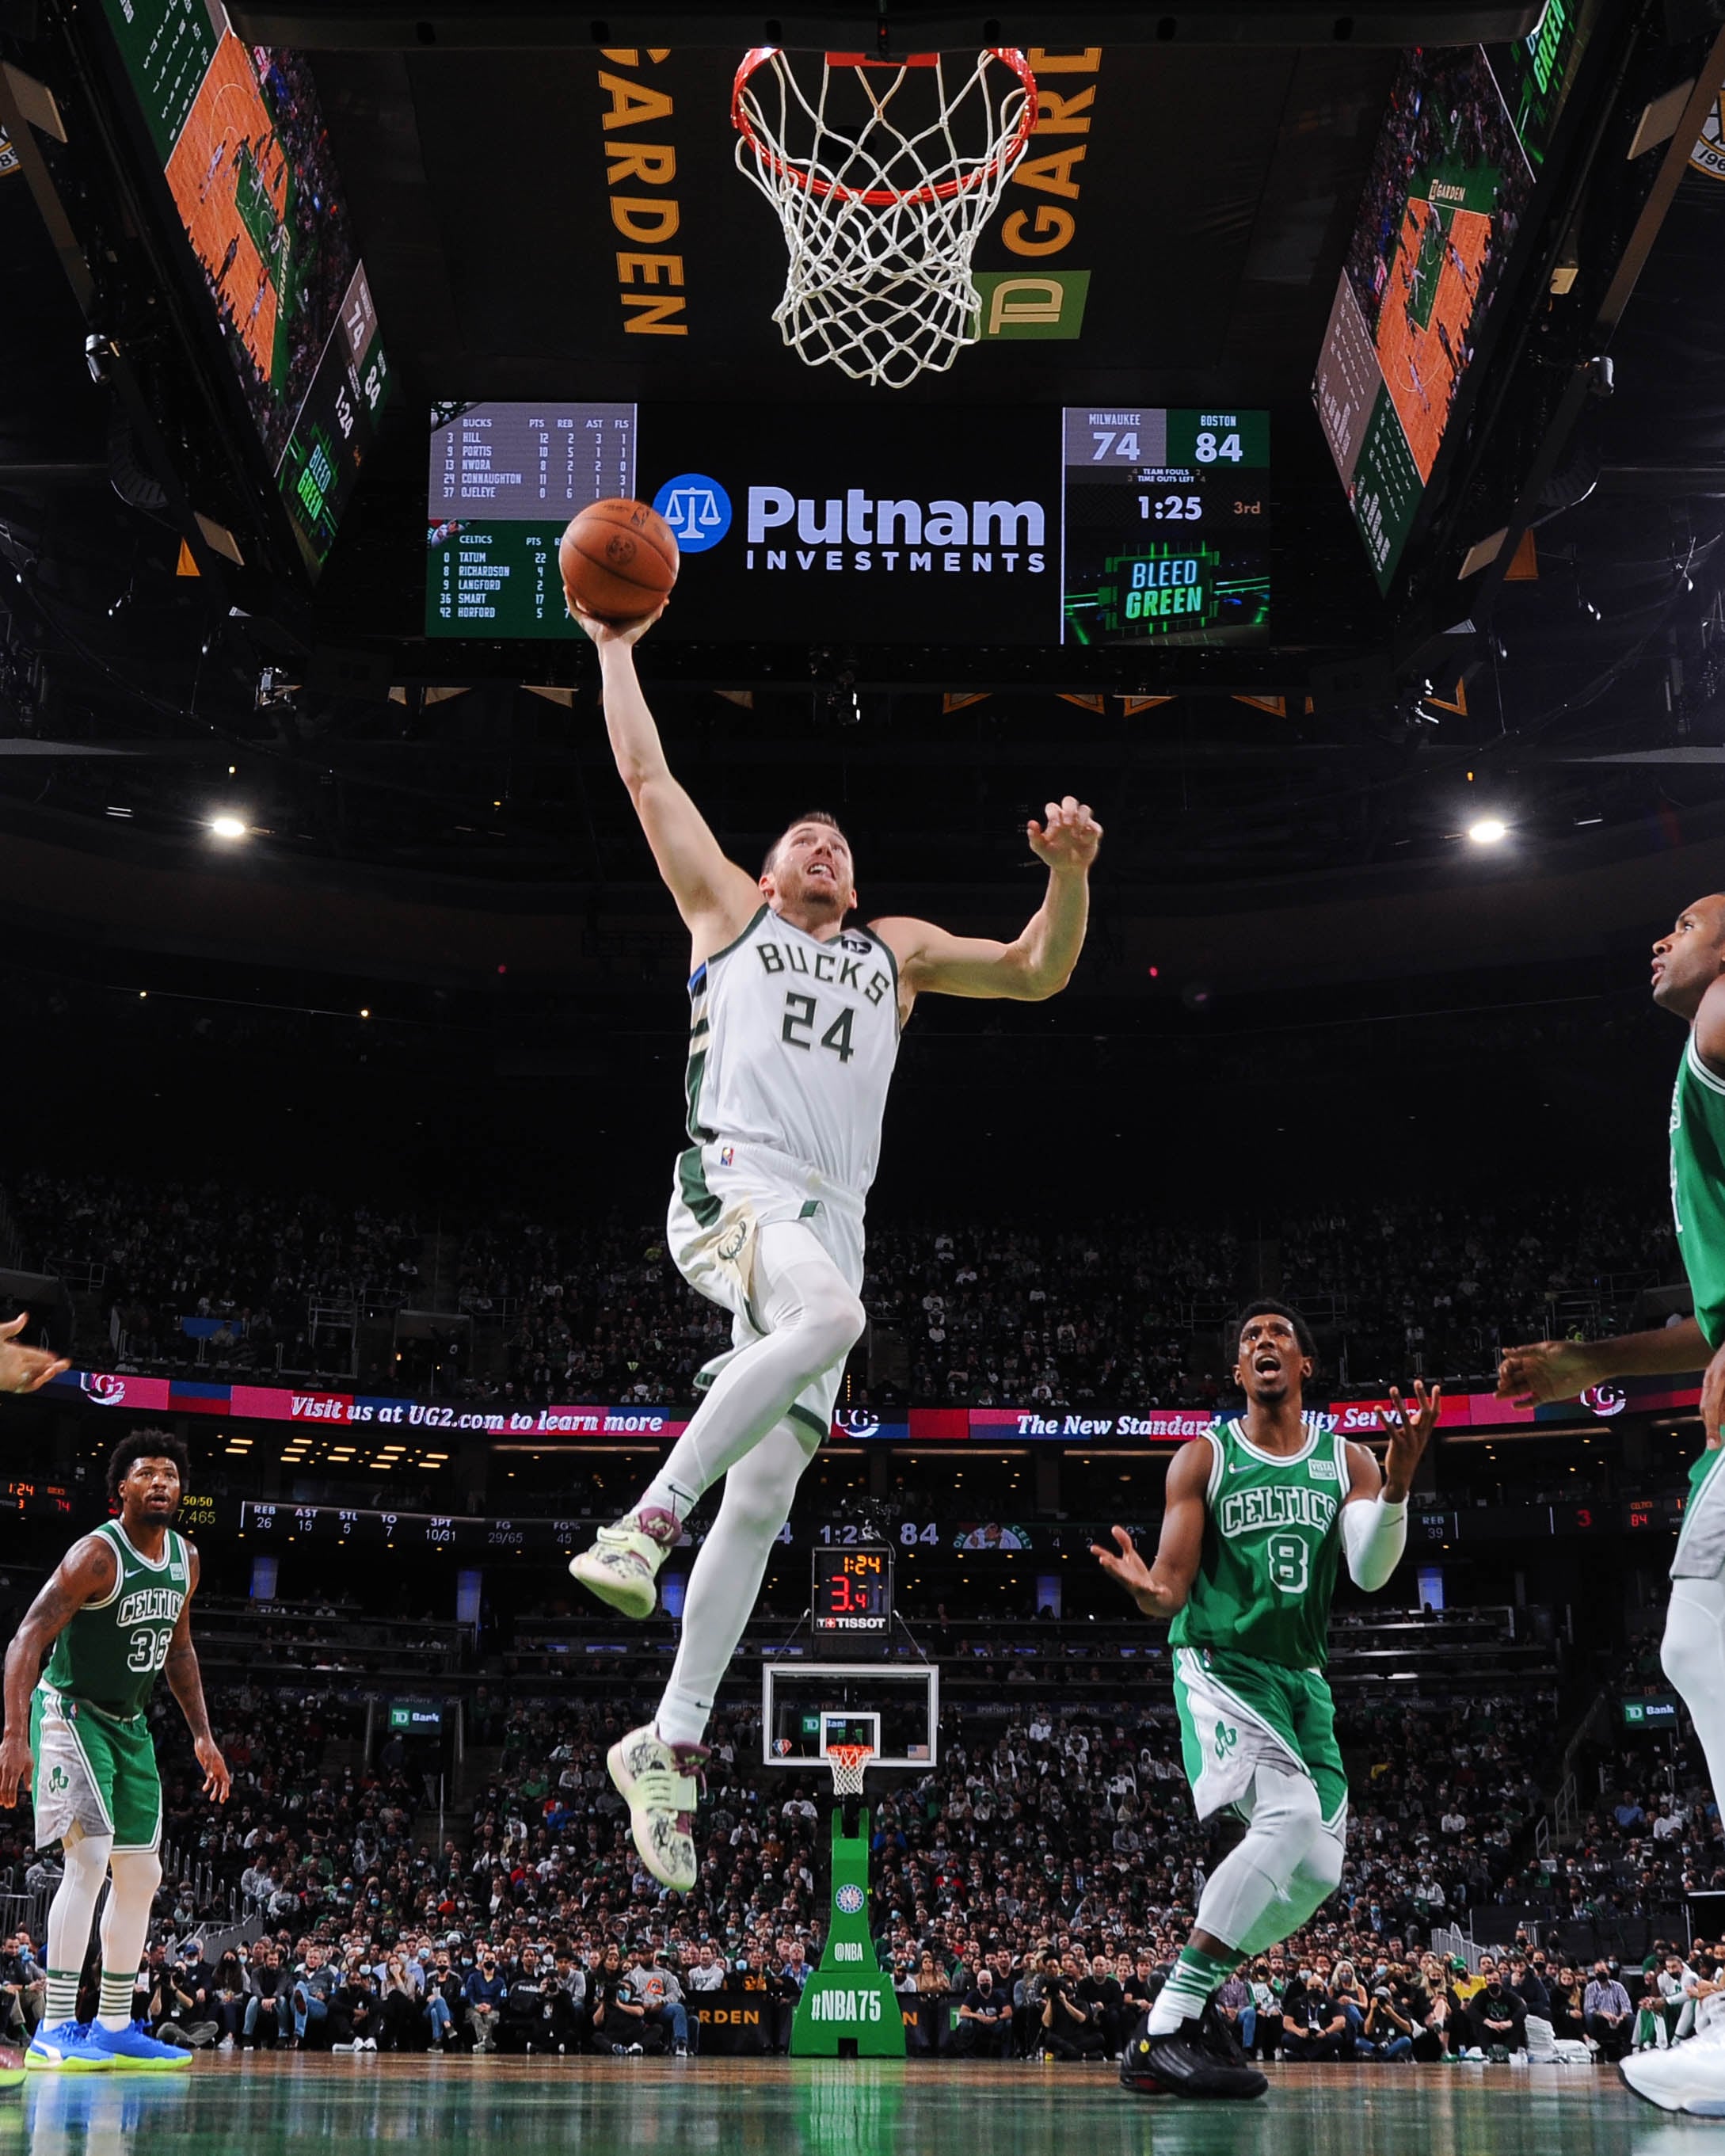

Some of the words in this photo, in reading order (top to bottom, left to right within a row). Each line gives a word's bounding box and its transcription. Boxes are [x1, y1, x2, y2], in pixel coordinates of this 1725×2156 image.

[988, 277, 1064, 334] TD
[558, 420, 573, 429] REB
[586, 420, 603, 429] AST
[1089, 413, 1140, 425] MILWAUKEE
[1201, 415, 1236, 426] BOSTON
[447, 433, 453, 443] 3
[463, 432, 481, 443] HILL
[540, 434, 548, 444] 12
[568, 434, 574, 444] 2
[596, 434, 601, 444] 3
[622, 434, 626, 444] 1
[447, 447, 453, 456] 9
[463, 447, 492, 456] PORTIS
[539, 448, 548, 457] 10
[567, 448, 573, 457] 5
[596, 448, 600, 457] 1
[622, 448, 626, 458] 1
[1092, 432, 1140, 461] 74
[1195, 432, 1243, 463] 84
[446, 460, 454, 470] 13
[462, 460, 490, 470] NWORA
[540, 461, 546, 470] 8
[567, 461, 573, 470] 2
[596, 461, 601, 470] 2
[620, 462, 626, 470] 0
[462, 474, 521, 484] CONNAUGHTON
[539, 474, 546, 484] 11
[568, 475, 572, 484] 1
[596, 475, 600, 485] 1
[619, 475, 626, 485] 3
[444, 488, 454, 497] 37
[462, 487, 496, 497] OJELEYE
[540, 488, 546, 497] 0
[566, 488, 572, 497] 6
[1138, 496, 1202, 520] 1:25
[1234, 501, 1261, 514] 3rd
[747, 486, 1045, 546] Putnam
[459, 535, 493, 544] CELTICS
[527, 537, 542, 546] PTS
[444, 553, 449, 562] 0
[459, 553, 486, 562] TATUM
[535, 554, 546, 563] 22
[747, 550, 1045, 573] INVESTMENTS
[444, 566, 449, 576] 8
[459, 566, 509, 577] RICHARDSON
[1133, 561, 1197, 589] BLEED
[444, 580, 449, 590] 9
[459, 580, 501, 590] LANGFORD
[537, 581, 543, 590] 2
[440, 593, 451, 604] 36
[459, 593, 486, 604] SMART
[536, 594, 544, 604] 17
[1125, 586, 1202, 619] GREEN
[459, 608, 495, 618] HORFORD
[537, 608, 543, 618] 5
[756, 943, 891, 1007] BUCKS
[781, 991, 855, 1064] 24
[291, 1396, 342, 1420] Visit
[347, 1404, 372, 1421] us
[379, 1407, 402, 1423] at
[409, 1407, 506, 1430] UG2.com
[510, 1411, 532, 1430] to
[537, 1411, 599, 1431] learn
[604, 1415, 662, 1432] more
[1017, 1415, 1060, 1434] The
[1064, 1415, 1112, 1435] New
[1117, 1415, 1221, 1435] Standard
[18, 1499, 25, 1510] 3
[183, 1495, 213, 1507] 50/50
[253, 1506, 276, 1515] REB
[295, 1509, 318, 1518] AST
[339, 1511, 358, 1521] STL
[382, 1514, 397, 1524] TO
[431, 1518, 451, 1528] 3PT
[496, 1521, 511, 1530] FG
[554, 1521, 581, 1531] FG%
[1220, 1486, 1337, 1538] CELTICS
[1577, 1509, 1593, 1527] 3
[1422, 1516, 1444, 1525] REB
[1631, 1514, 1648, 1527] 84
[257, 1517, 272, 1529] 26
[299, 1520, 313, 1532] 15
[343, 1522, 351, 1534] 5
[386, 1526, 393, 1537] 7
[425, 1529, 456, 1541] 10/31
[488, 1532, 524, 1545] 29/65
[557, 1533, 573, 1545] 45
[775, 1522, 793, 1545] 4
[900, 1523, 939, 1545] 84
[1427, 1528, 1443, 1539] 39
[844, 1555, 881, 1575] 1:24
[1267, 1534, 1308, 1594] 8
[831, 1576, 866, 1611] 3.4
[836, 1618, 885, 1628] TISSOT
[128, 1628, 172, 1672] 36
[412, 1712, 440, 1723] Bank
[1646, 1704, 1675, 1716] Bank
[835, 1943, 863, 1962] @NBA
[811, 1990, 881, 2021] #NBA75
[699, 2009, 760, 2025] RDEN
